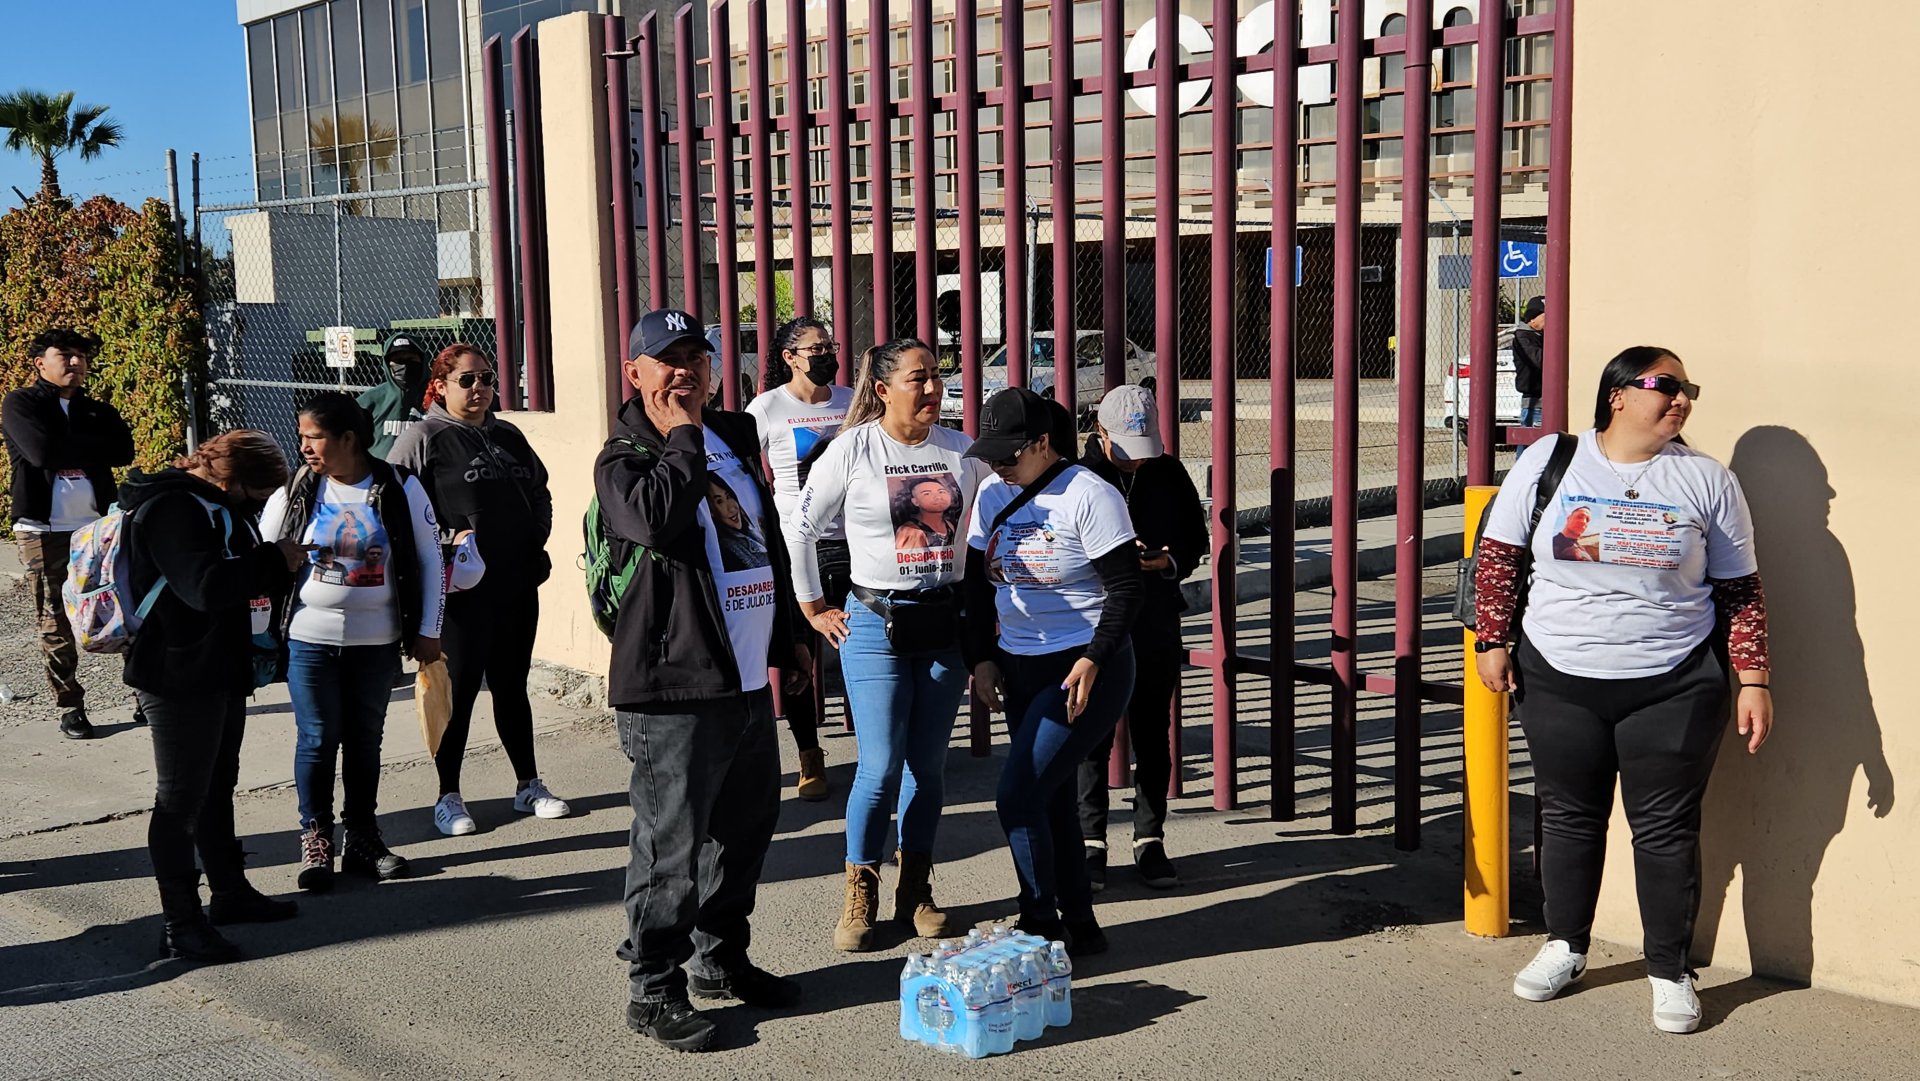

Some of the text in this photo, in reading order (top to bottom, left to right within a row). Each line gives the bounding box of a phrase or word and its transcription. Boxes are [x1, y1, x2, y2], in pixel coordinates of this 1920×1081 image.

[665, 312, 688, 331] NY
[788, 416, 833, 425] ELIZABETH
[464, 465, 532, 483] adidas
[884, 461, 949, 475] Erick Carrillo
[727, 580, 775, 599] DESAPAREC
[733, 599, 745, 611] DE
[746, 595, 766, 609] JULIO
